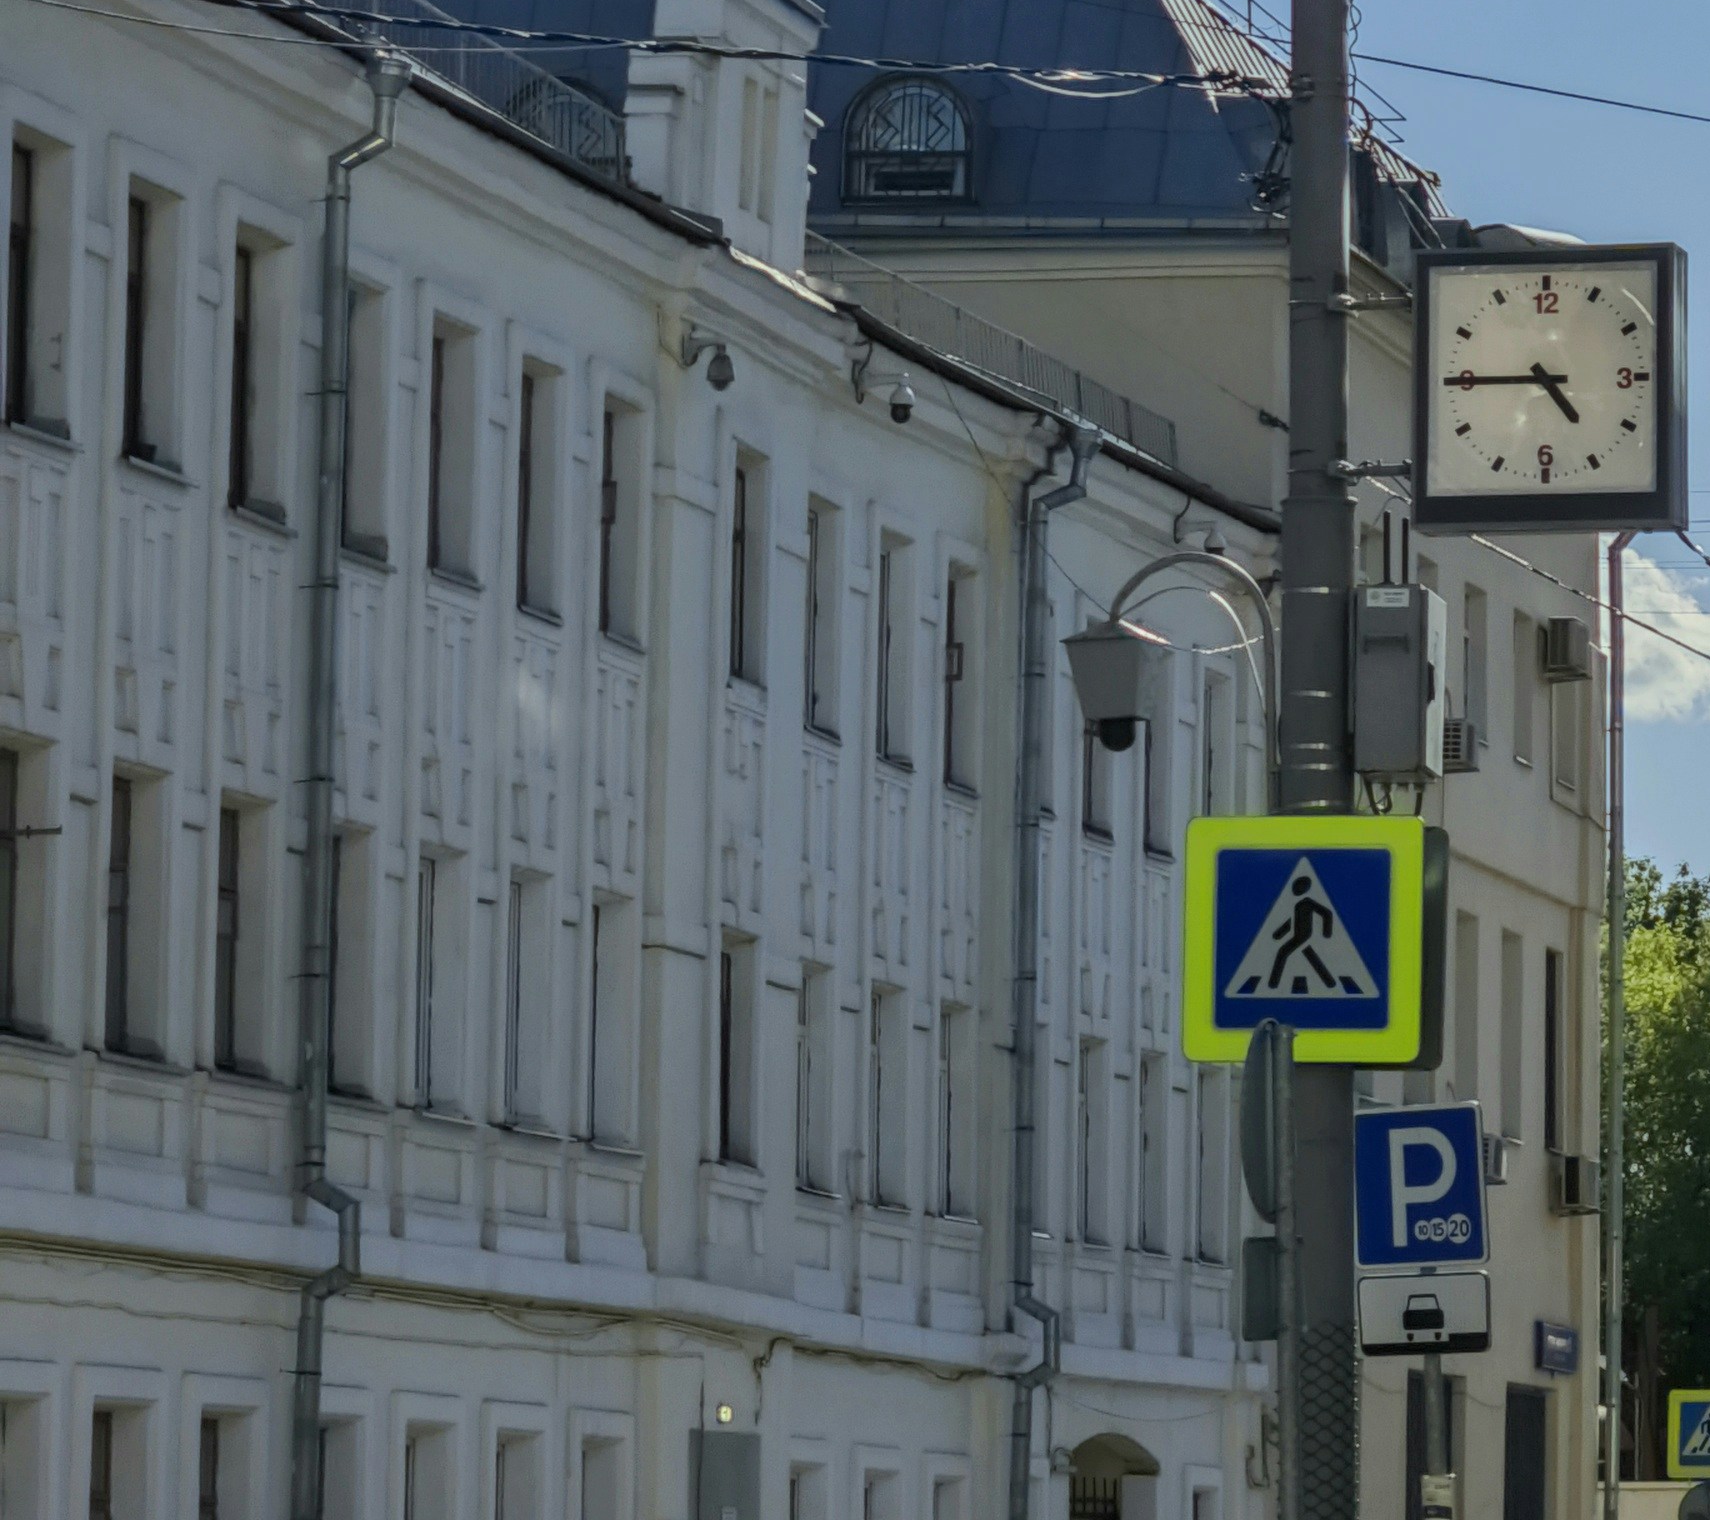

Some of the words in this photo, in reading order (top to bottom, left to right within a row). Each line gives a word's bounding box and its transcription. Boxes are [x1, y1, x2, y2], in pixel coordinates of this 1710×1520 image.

[1532, 293, 1559, 314] 12
[1616, 367, 1633, 389] 3
[1537, 444, 1553, 467] 6
[1388, 1126, 1457, 1248] P
[1418, 1224, 1428, 1236] 10
[1432, 1222, 1444, 1237] 15
[1449, 1219, 1469, 1237] 20
